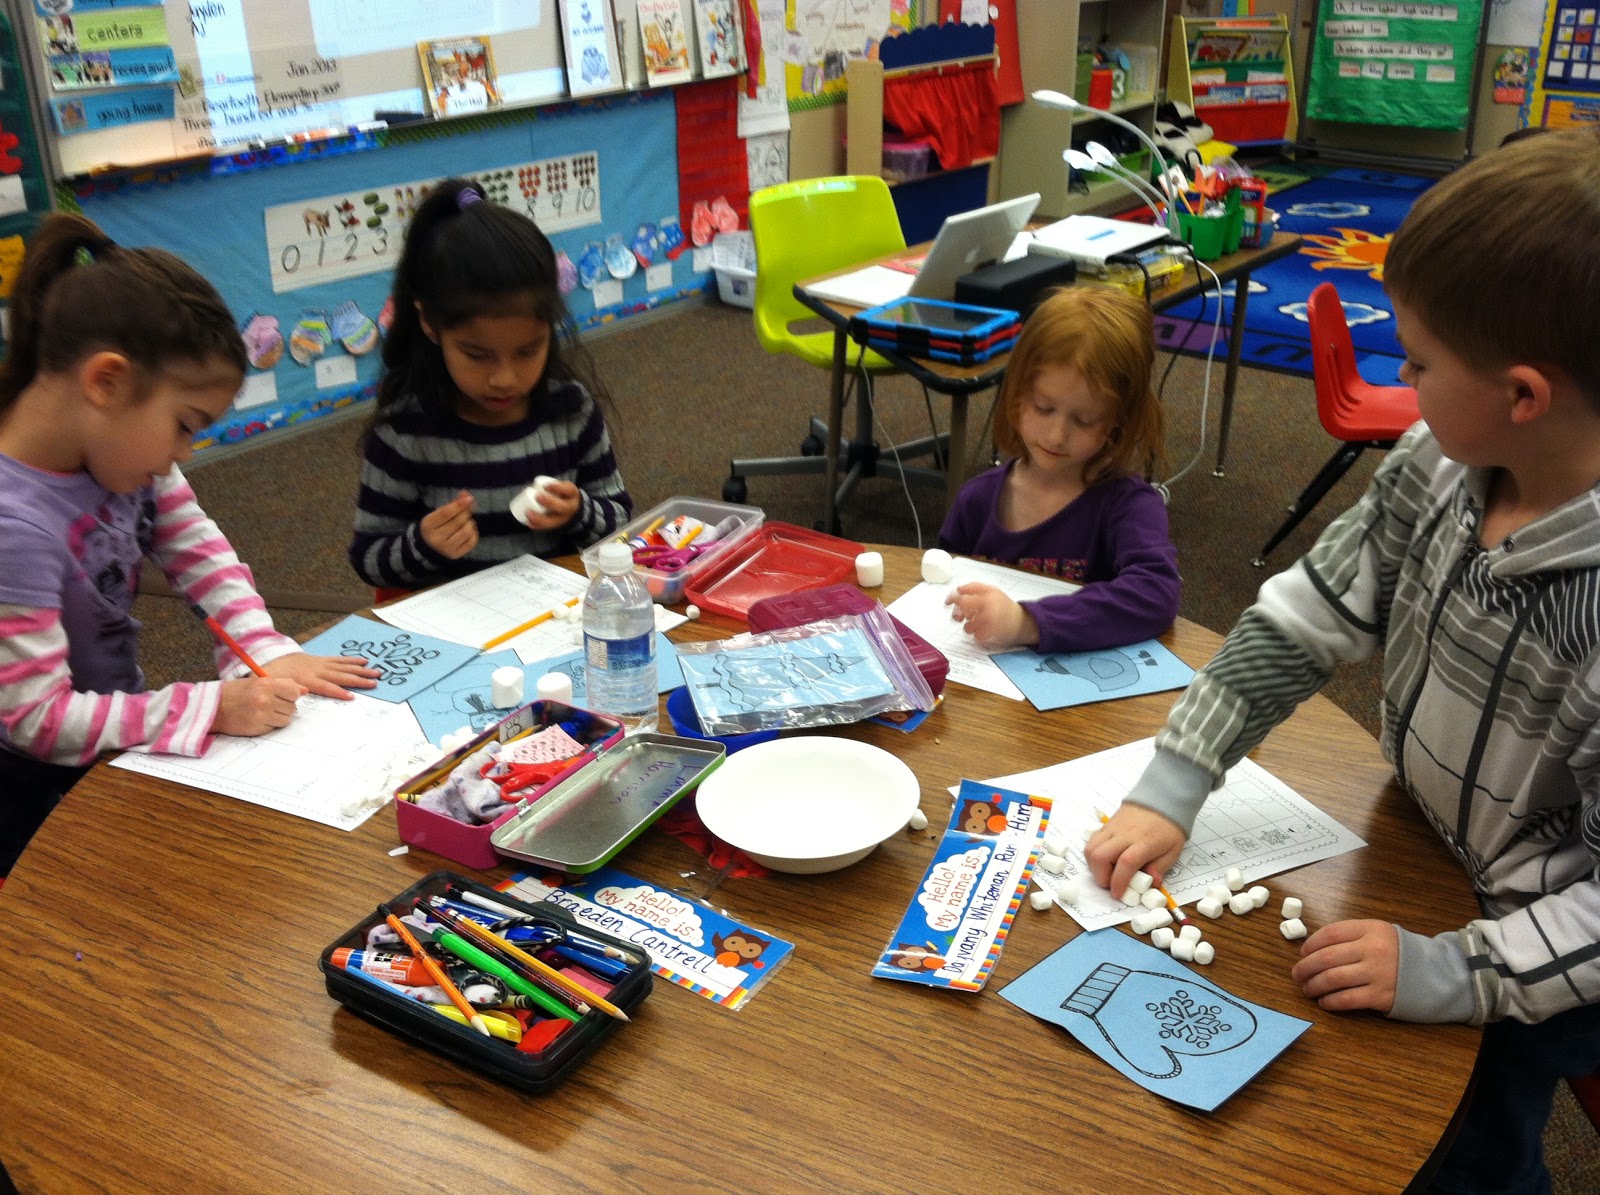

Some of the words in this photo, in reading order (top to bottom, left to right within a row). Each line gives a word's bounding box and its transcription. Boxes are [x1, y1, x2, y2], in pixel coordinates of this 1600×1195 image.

[87, 21, 143, 42] centers
[282, 244, 301, 274] 0
[344, 232, 359, 262] 2
[371, 227, 389, 256] 3
[551, 192, 564, 218] 9
[575, 186, 597, 214] 10
[927, 866, 955, 904] Hello!
[970, 868, 1011, 922] Whiteman
[1007, 799, 1034, 833] Him
[597, 889, 625, 909] My
[626, 900, 671, 929] name
[638, 889, 688, 918] Hello!
[934, 910, 957, 930] My
[948, 872, 974, 909] name
[543, 888, 624, 934] Braeden
[629, 927, 715, 975] Cantrell
